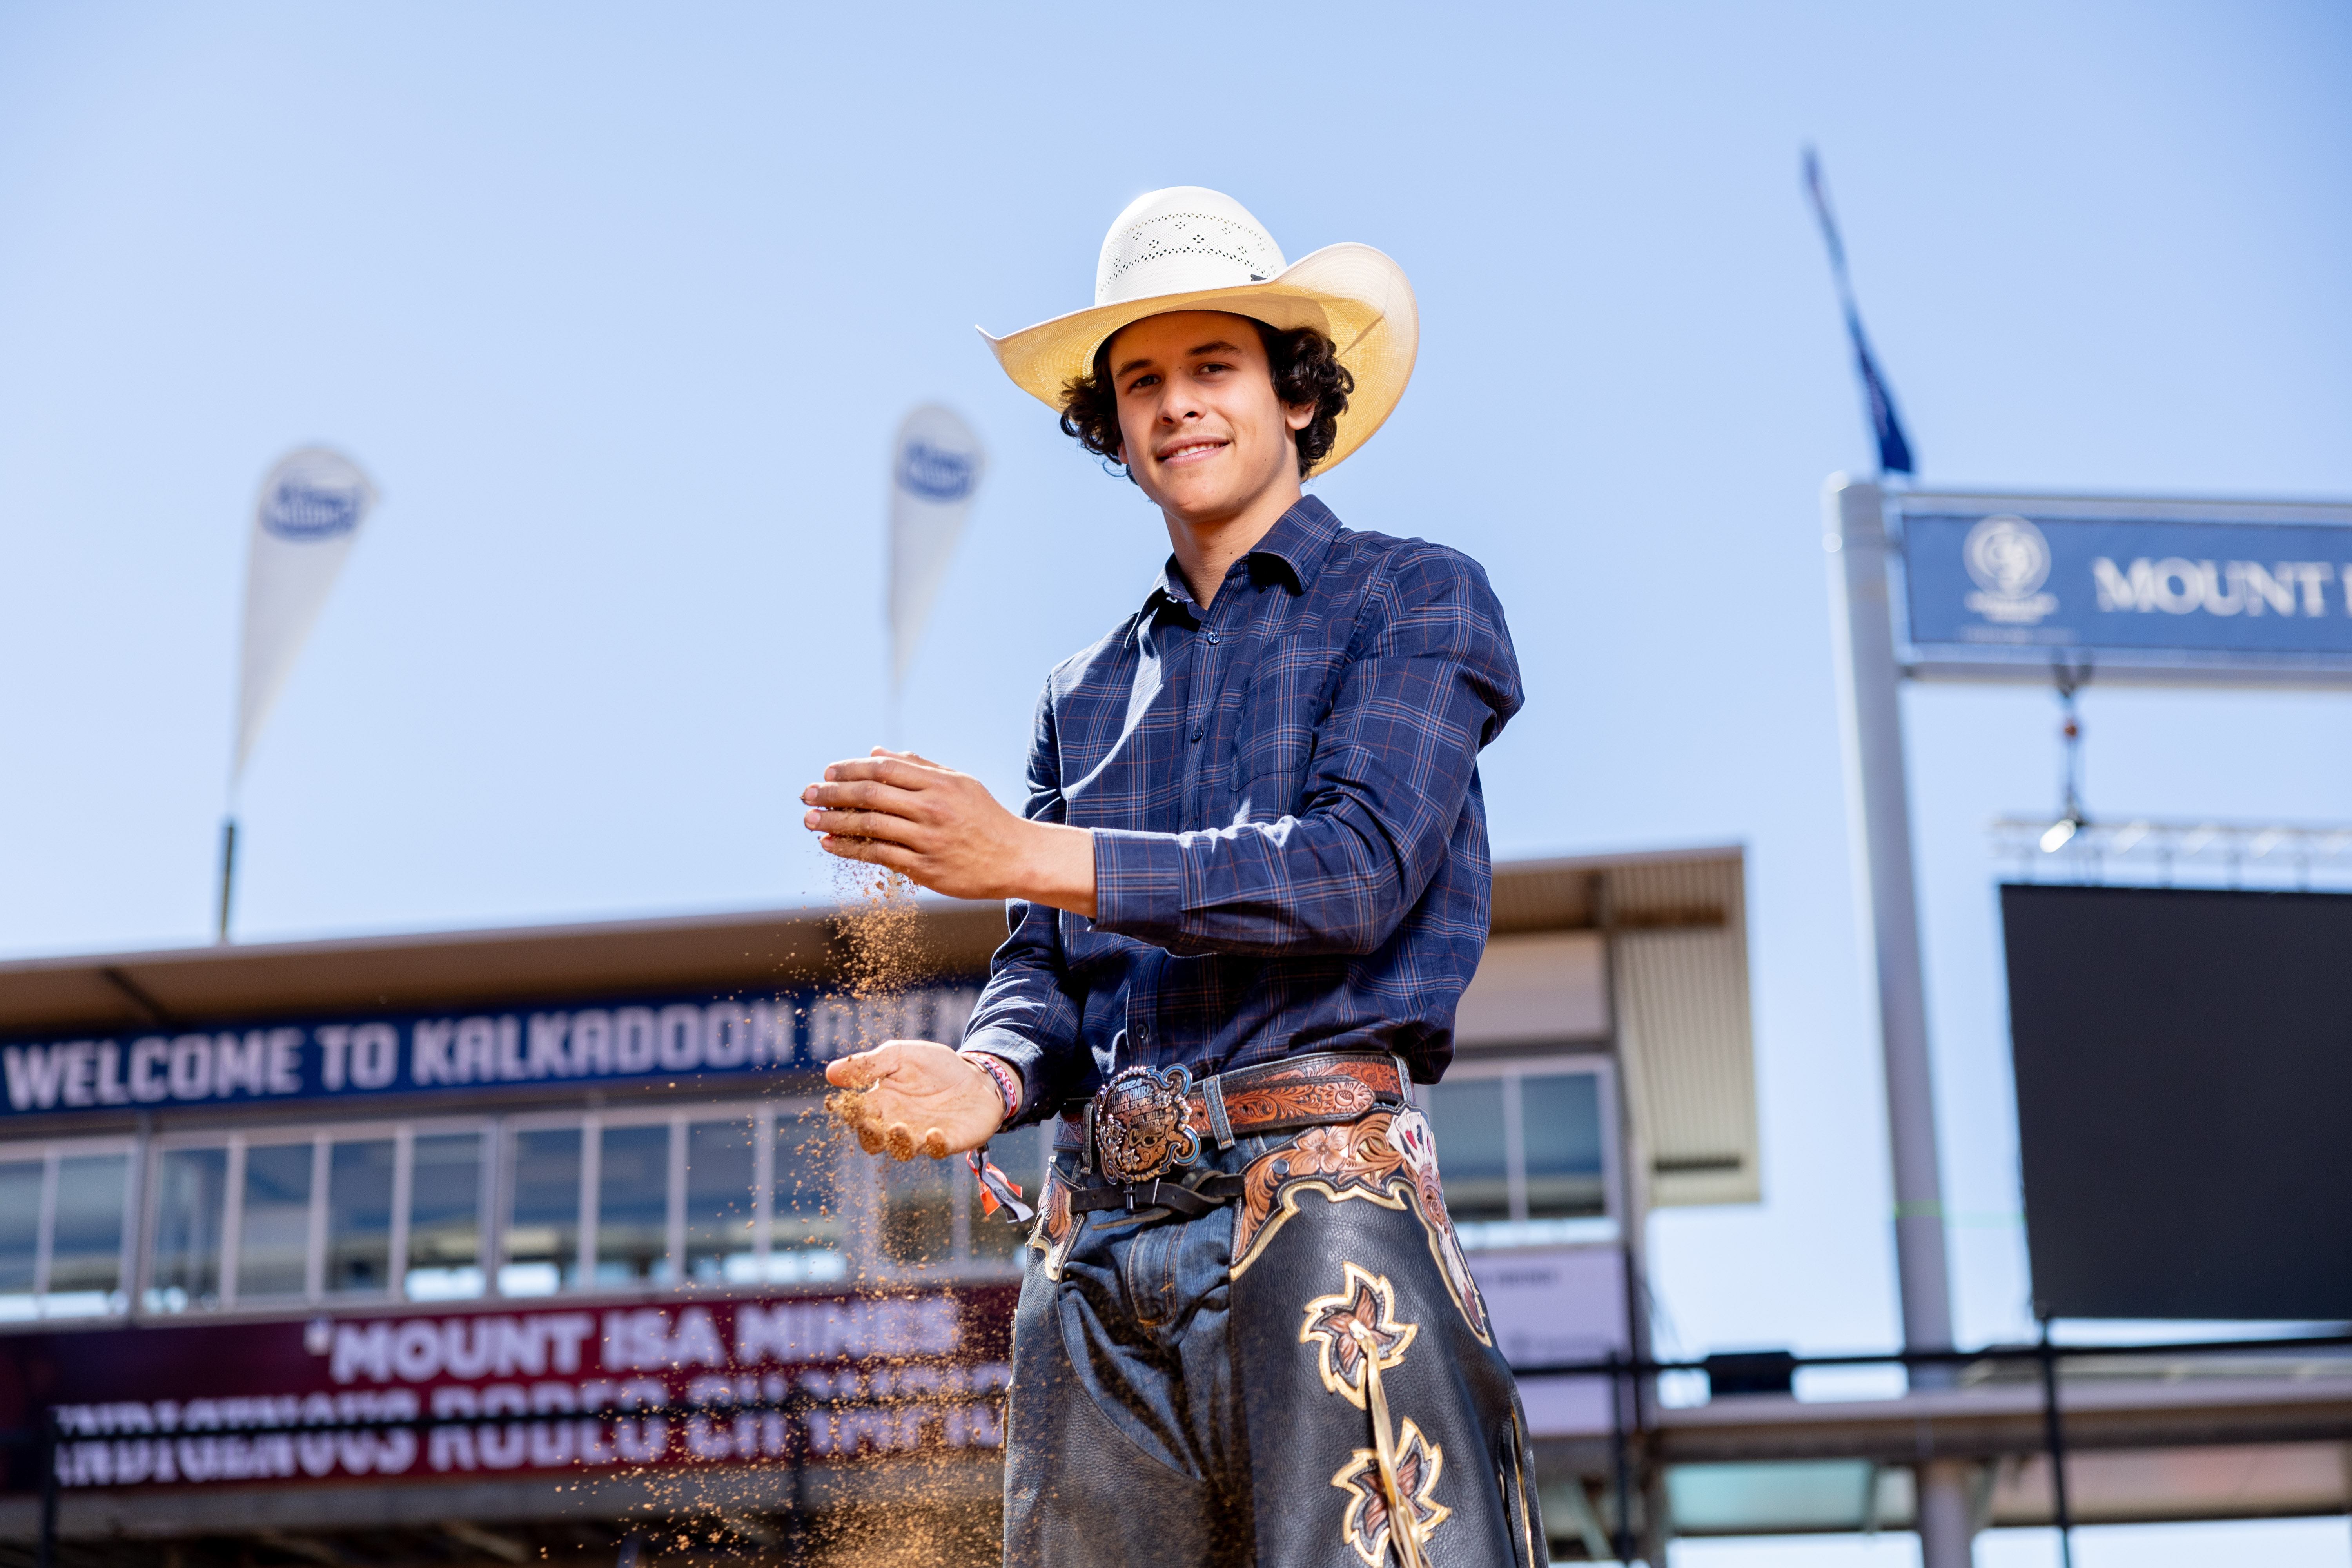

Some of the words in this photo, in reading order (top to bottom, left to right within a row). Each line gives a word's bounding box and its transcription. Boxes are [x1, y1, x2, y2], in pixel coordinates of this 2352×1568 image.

[2091, 557, 2333, 618] MOUNT
[4, 1027, 304, 1110] WELCOME
[314, 1022, 399, 1091] TO
[410, 1000, 795, 1086] KALKADOON
[1118, 1078, 1142, 1092] 2024
[1131, 1096, 1153, 1109] SPURS
[1138, 1119, 1160, 1131] RIDER
[1146, 1110, 1166, 1121] BULL
[330, 1312, 594, 1385] MOUNT
[601, 1305, 726, 1374] ISA
[735, 1297, 959, 1365] MINES
[56, 1387, 419, 1486] INDIGENOUS
[429, 1376, 670, 1471] RODEO
